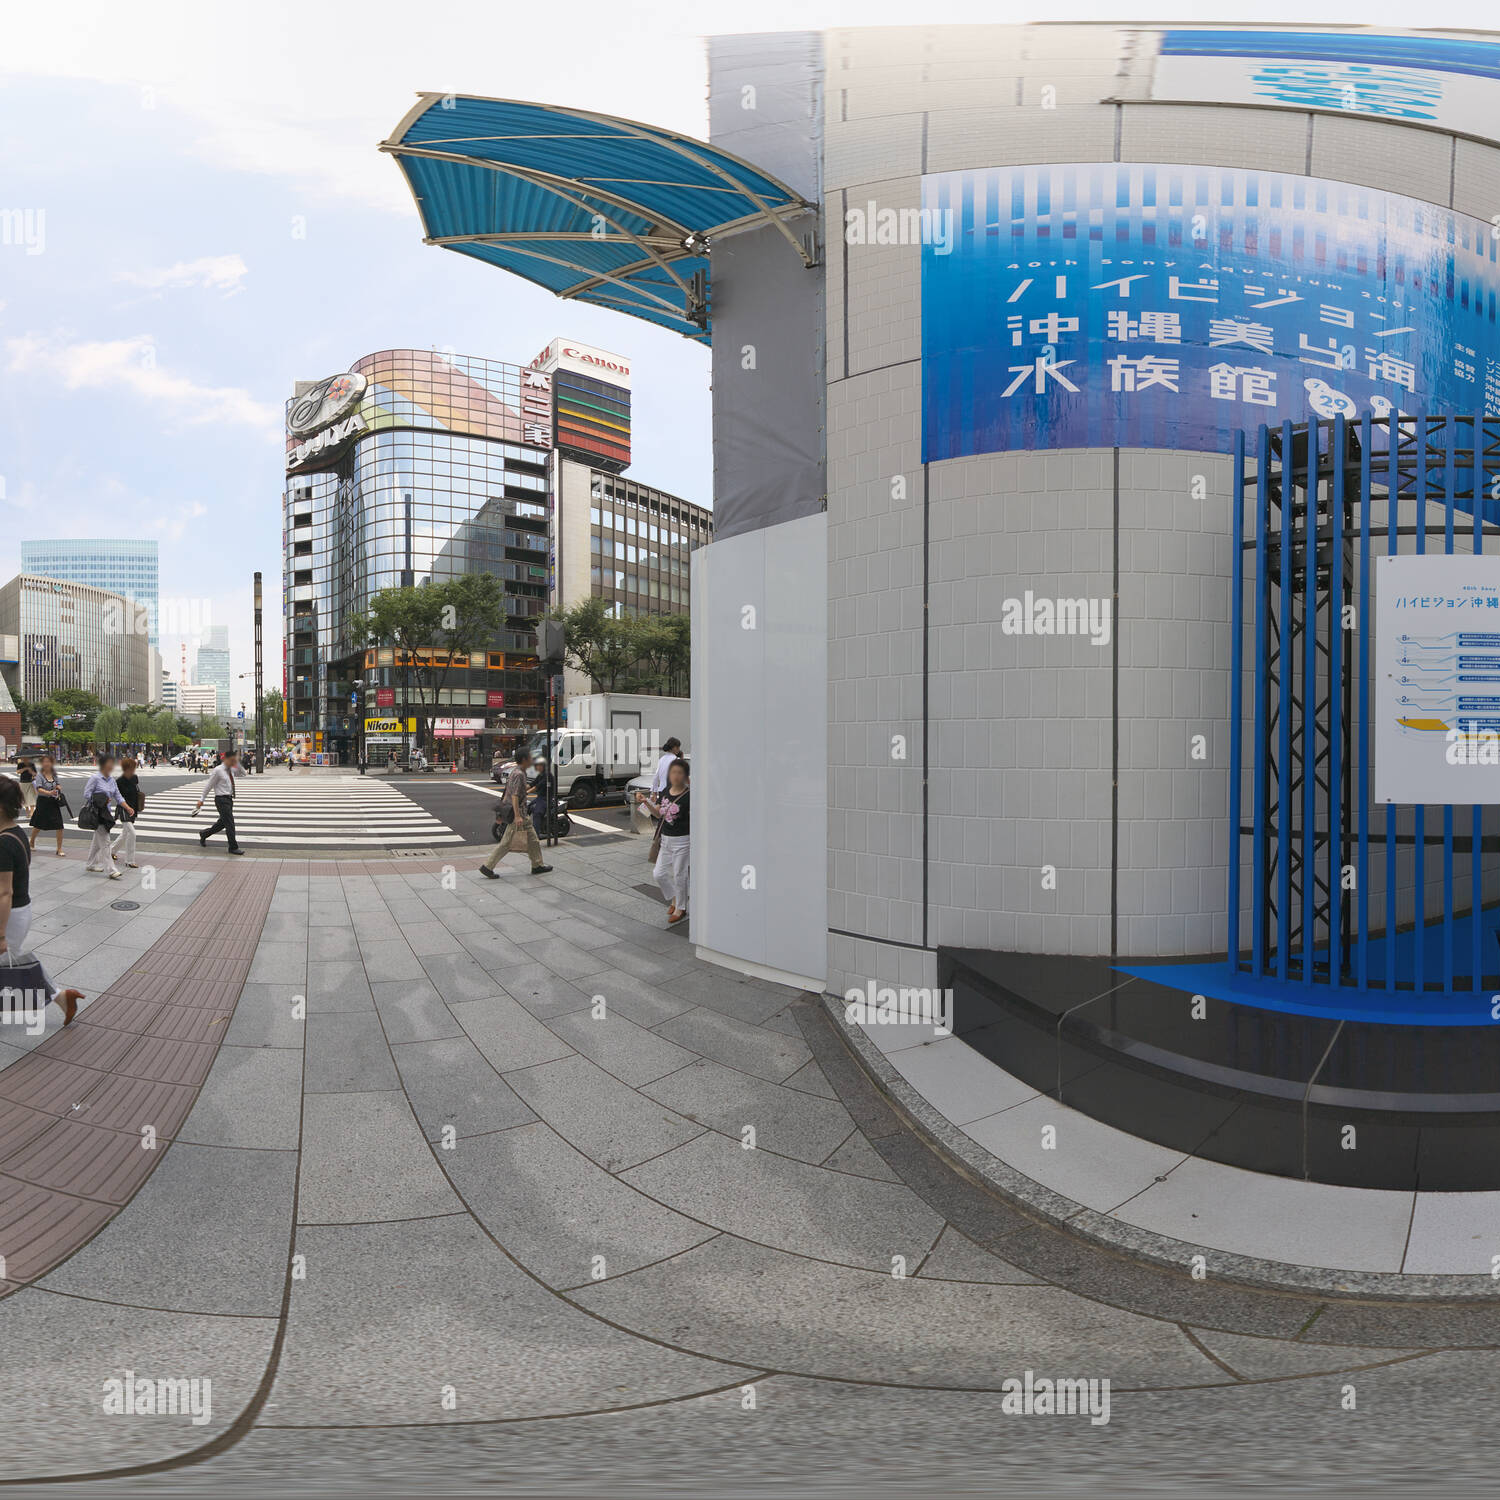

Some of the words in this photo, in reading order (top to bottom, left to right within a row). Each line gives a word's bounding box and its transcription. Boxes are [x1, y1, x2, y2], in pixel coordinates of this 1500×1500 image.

[1006, 259, 1078, 270] 40th
[1101, 258, 1177, 269] Sony
[1198, 262, 1343, 292] Aquarium
[1360, 290, 1417, 313] 2007
[1007, 274, 1417, 337] ハイビジョン
[562, 347, 631, 376] Canon
[1007, 311, 1416, 393] 沖縄美ら海
[523, 369, 551, 447] 不二家
[1000, 354, 1278, 407] 水族館
[1319, 395, 1349, 411] 29
[286, 413, 369, 470] FUJIYA
[366, 720, 397, 732] Nikon
